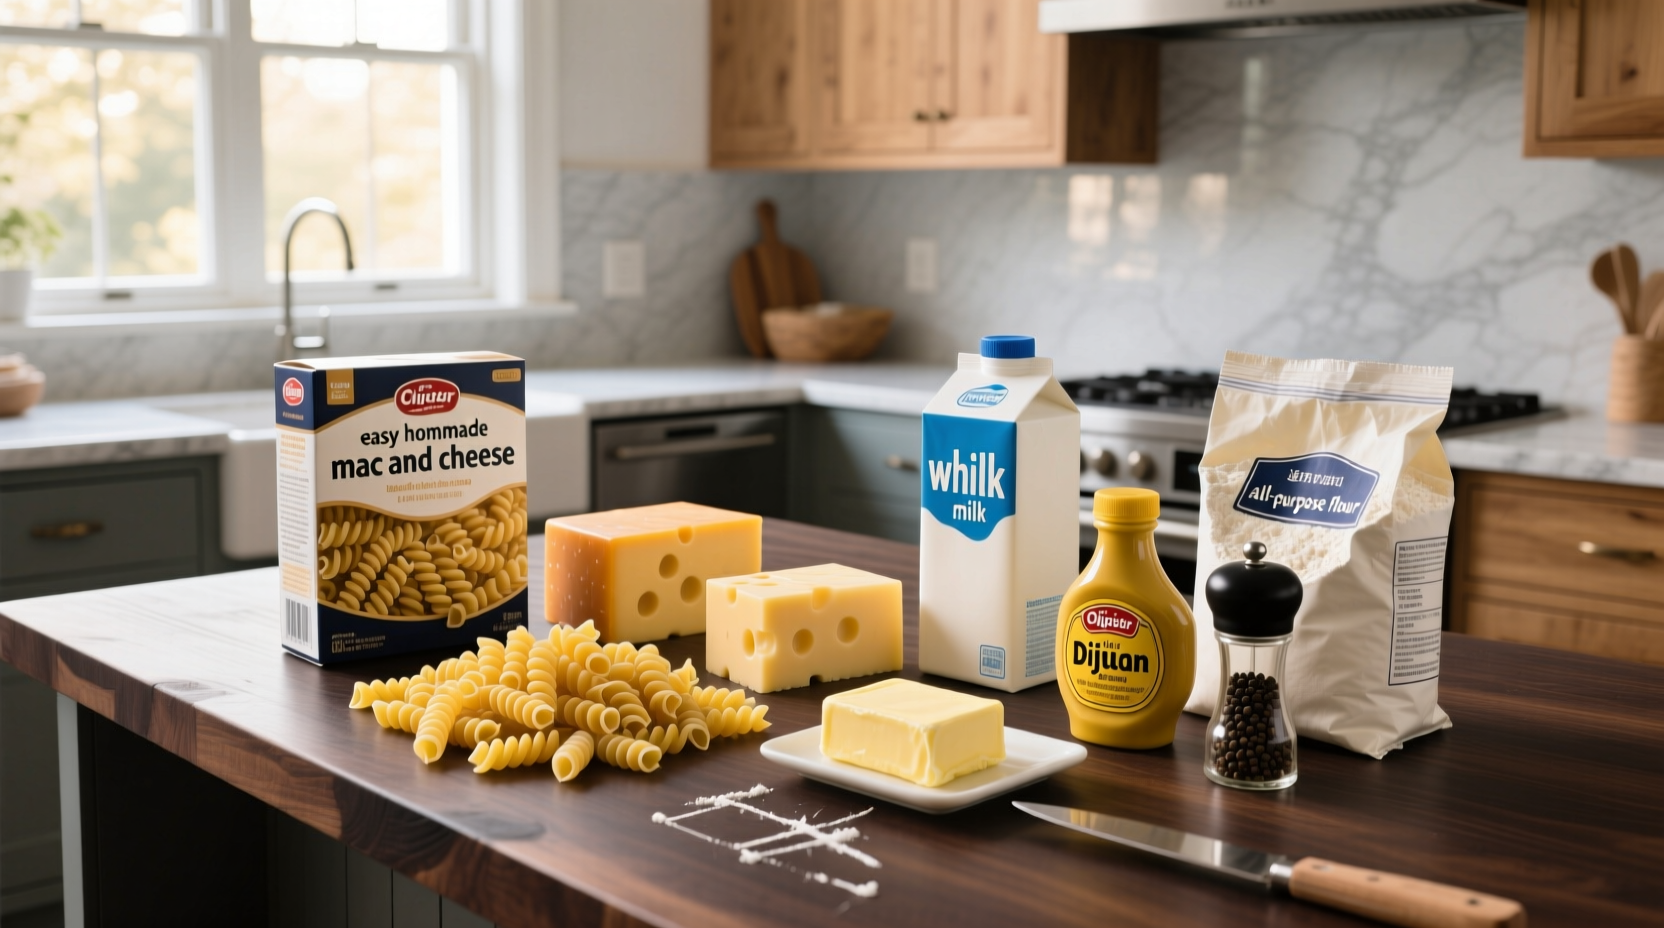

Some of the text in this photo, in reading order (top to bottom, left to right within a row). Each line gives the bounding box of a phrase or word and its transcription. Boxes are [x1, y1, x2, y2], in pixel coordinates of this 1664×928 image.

[360, 418, 488, 448] easy hommade
[332, 444, 515, 480] mac and cheese
[928, 449, 1006, 499] whilk
[952, 500, 987, 523] milk
[1073, 640, 1149, 675] Dijuan
